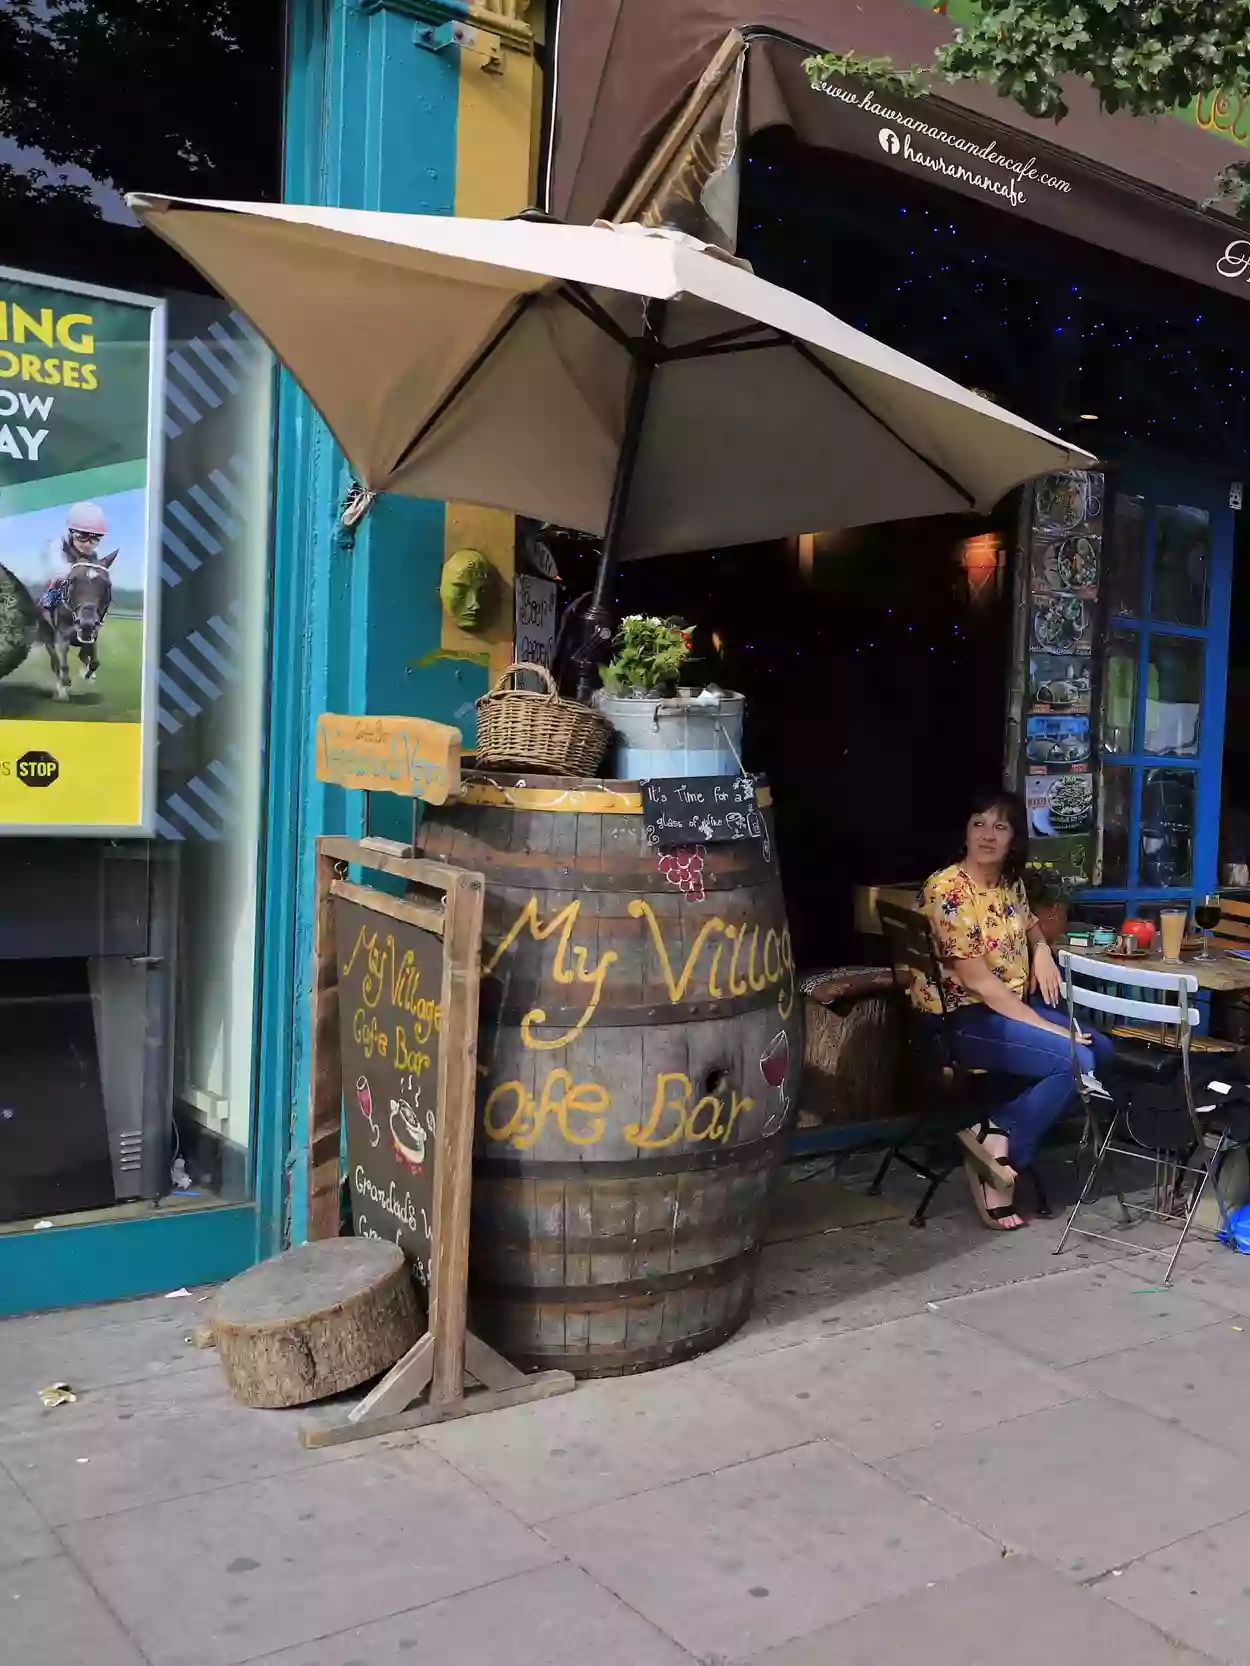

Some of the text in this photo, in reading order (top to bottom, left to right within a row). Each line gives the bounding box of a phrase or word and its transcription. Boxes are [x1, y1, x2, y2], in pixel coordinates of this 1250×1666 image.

[903, 134, 1027, 207] hawramancafe
[19, 761, 57, 777] STOP
[674, 784, 705, 803] Time
[714, 786, 729, 804] for
[657, 812, 683, 830] glass
[689, 815, 700, 828] of
[343, 925, 388, 1008] My
[480, 895, 618, 1050] My
[354, 1008, 431, 1077] Cafe Bar
[624, 1072, 755, 1149] Bar
[355, 1164, 418, 1232] Grandad's
